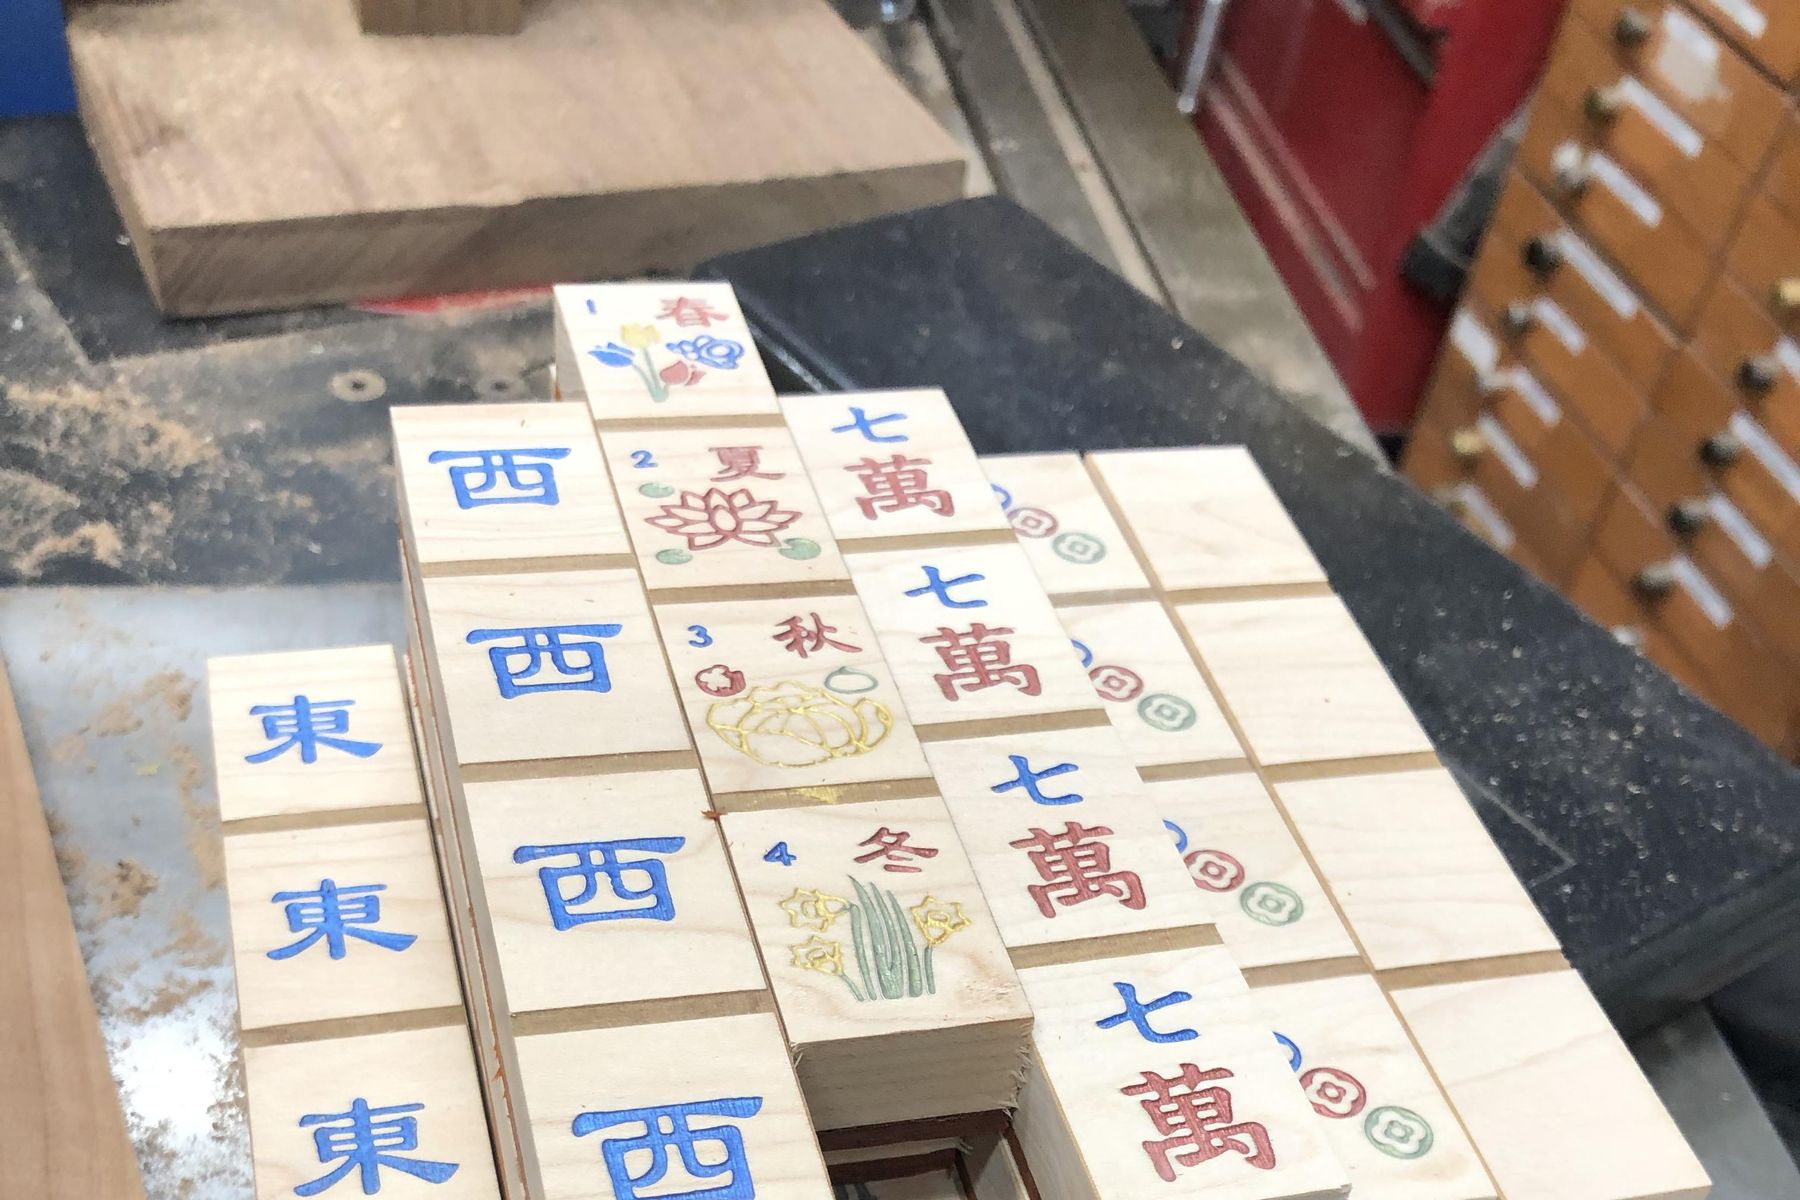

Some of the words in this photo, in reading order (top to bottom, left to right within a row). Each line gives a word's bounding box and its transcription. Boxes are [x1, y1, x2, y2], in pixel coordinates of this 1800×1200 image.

[655, 296, 729, 328] 春
[428, 447, 570, 510] 西
[630, 449, 657, 469] 2
[708, 445, 786, 483] 夏
[465, 623, 622, 700] 西
[688, 624, 713, 648] 3
[773, 613, 863, 658] 秋
[245, 694, 381, 764] 東
[763, 841, 796, 866] 4
[855, 826, 939, 874] 冬
[512, 836, 686, 932] 西
[266, 878, 416, 961] 東
[294, 1097, 459, 1197] 東
